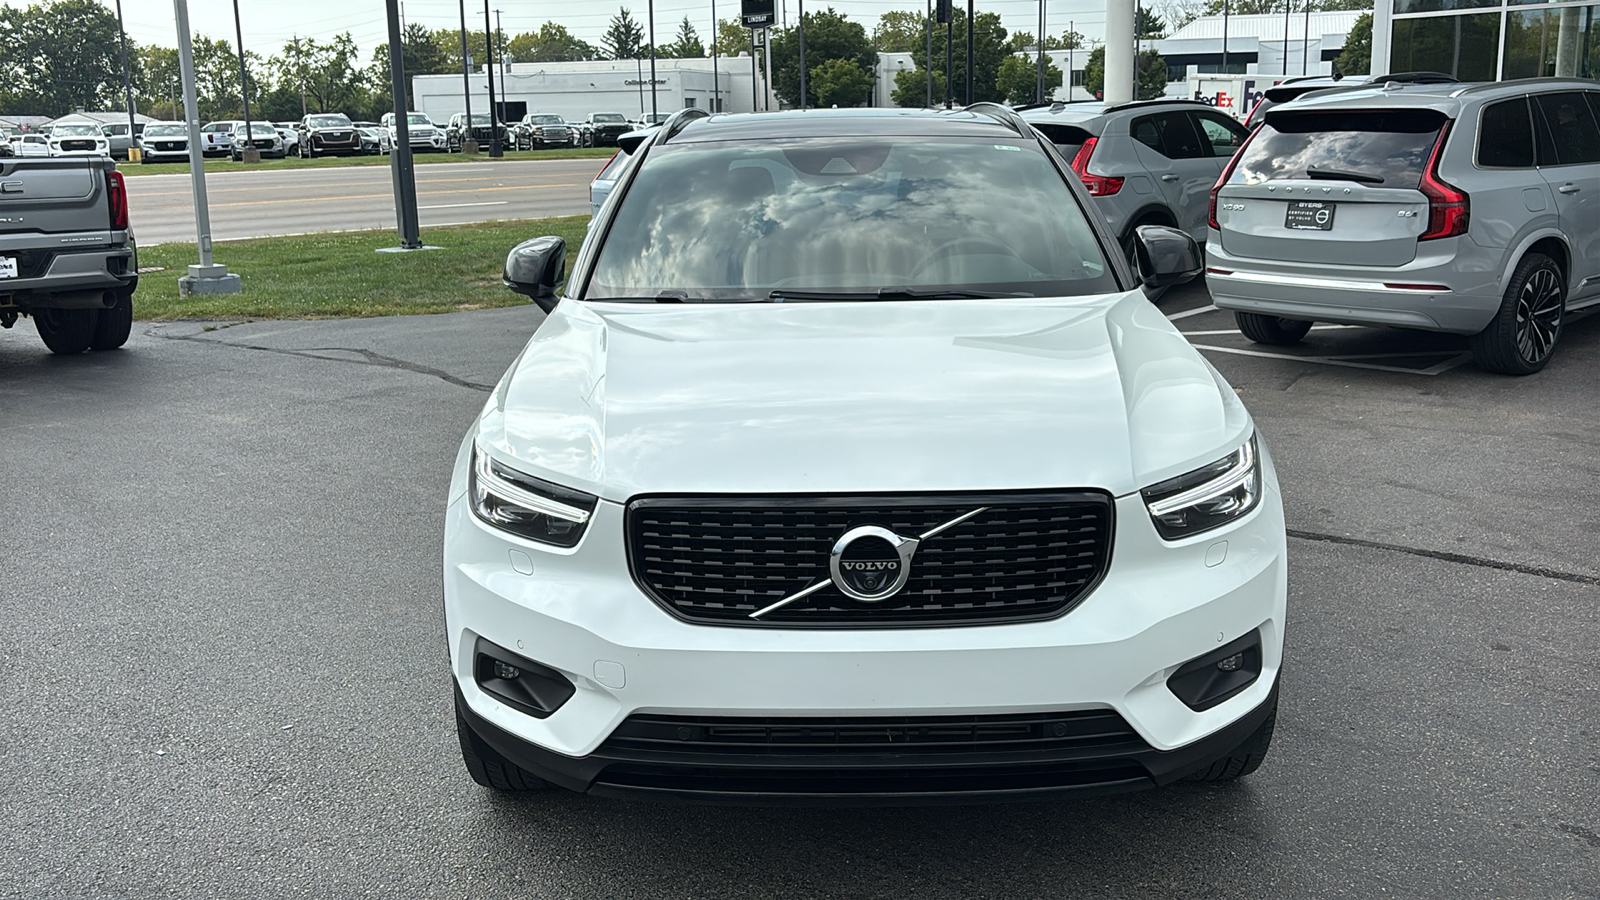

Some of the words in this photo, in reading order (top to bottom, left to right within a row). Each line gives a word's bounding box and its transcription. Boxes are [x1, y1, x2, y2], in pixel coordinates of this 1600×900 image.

[1194, 91, 1234, 108] FedEx
[1267, 186, 1351, 195] VOLVO
[1222, 203, 1246, 211] XC90
[842, 561, 898, 571] VOLVO
